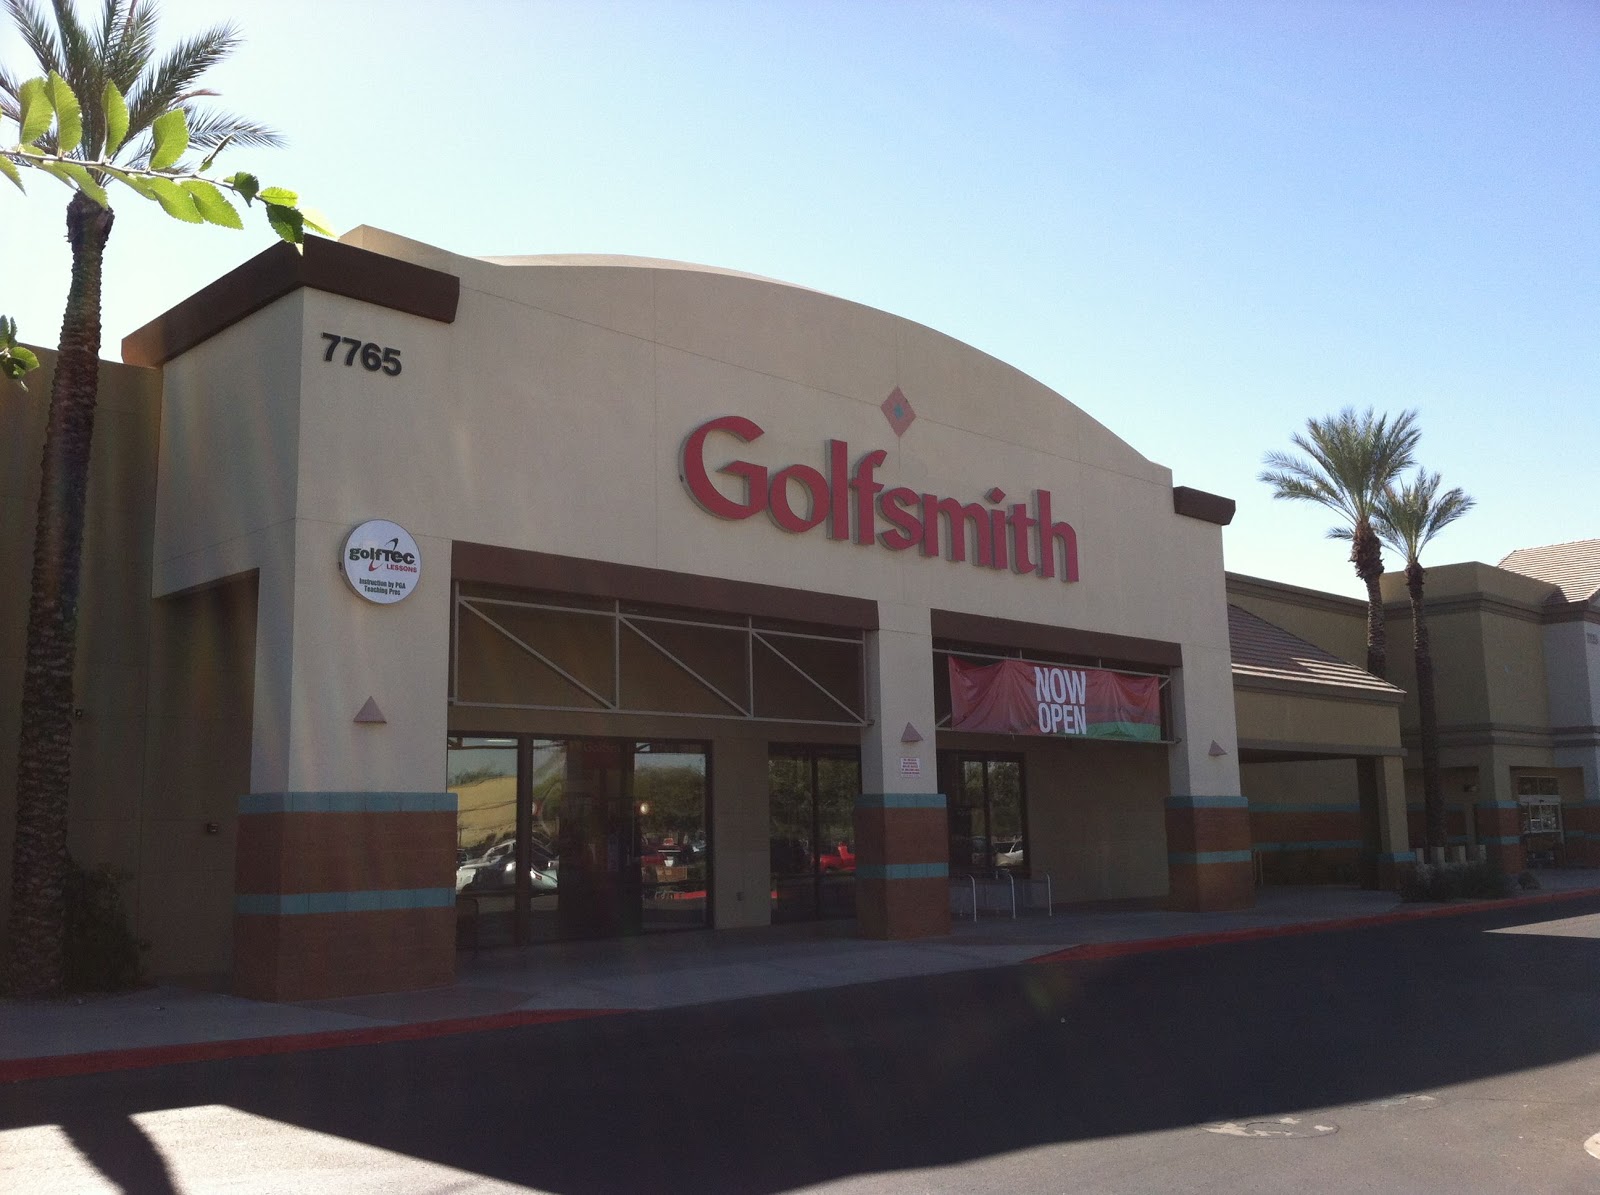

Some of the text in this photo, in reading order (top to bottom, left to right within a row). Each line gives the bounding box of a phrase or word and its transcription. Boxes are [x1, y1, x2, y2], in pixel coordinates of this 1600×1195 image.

[321, 332, 402, 376] 7765
[679, 415, 1079, 582] Golfsmith
[359, 578, 387, 587] Instruction
[388, 580, 395, 589] by
[386, 564, 417, 573] LESSONS
[364, 585, 401, 596] Teaching Pros
[1034, 666, 1087, 705] NOW
[1038, 702, 1087, 735] OPEN
